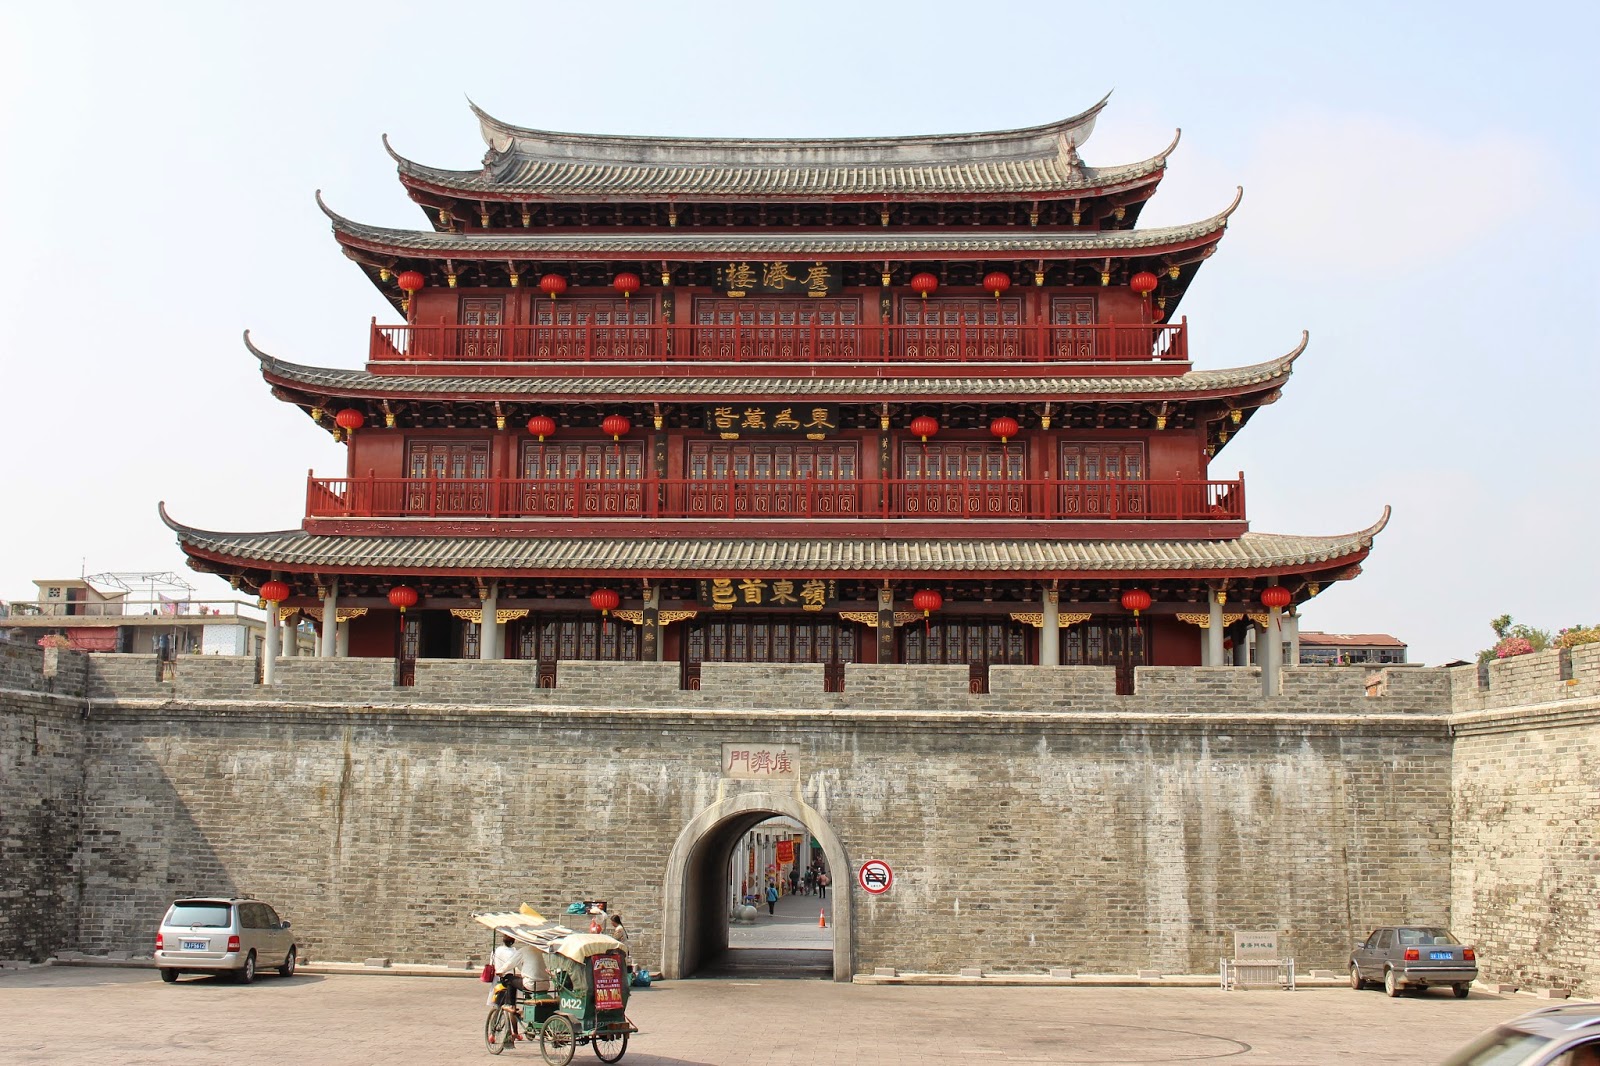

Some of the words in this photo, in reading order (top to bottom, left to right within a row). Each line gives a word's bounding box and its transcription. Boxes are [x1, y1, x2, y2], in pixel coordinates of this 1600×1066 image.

[711, 578, 826, 604] 嶺東首邑
[561, 998, 582, 1009] 0422
